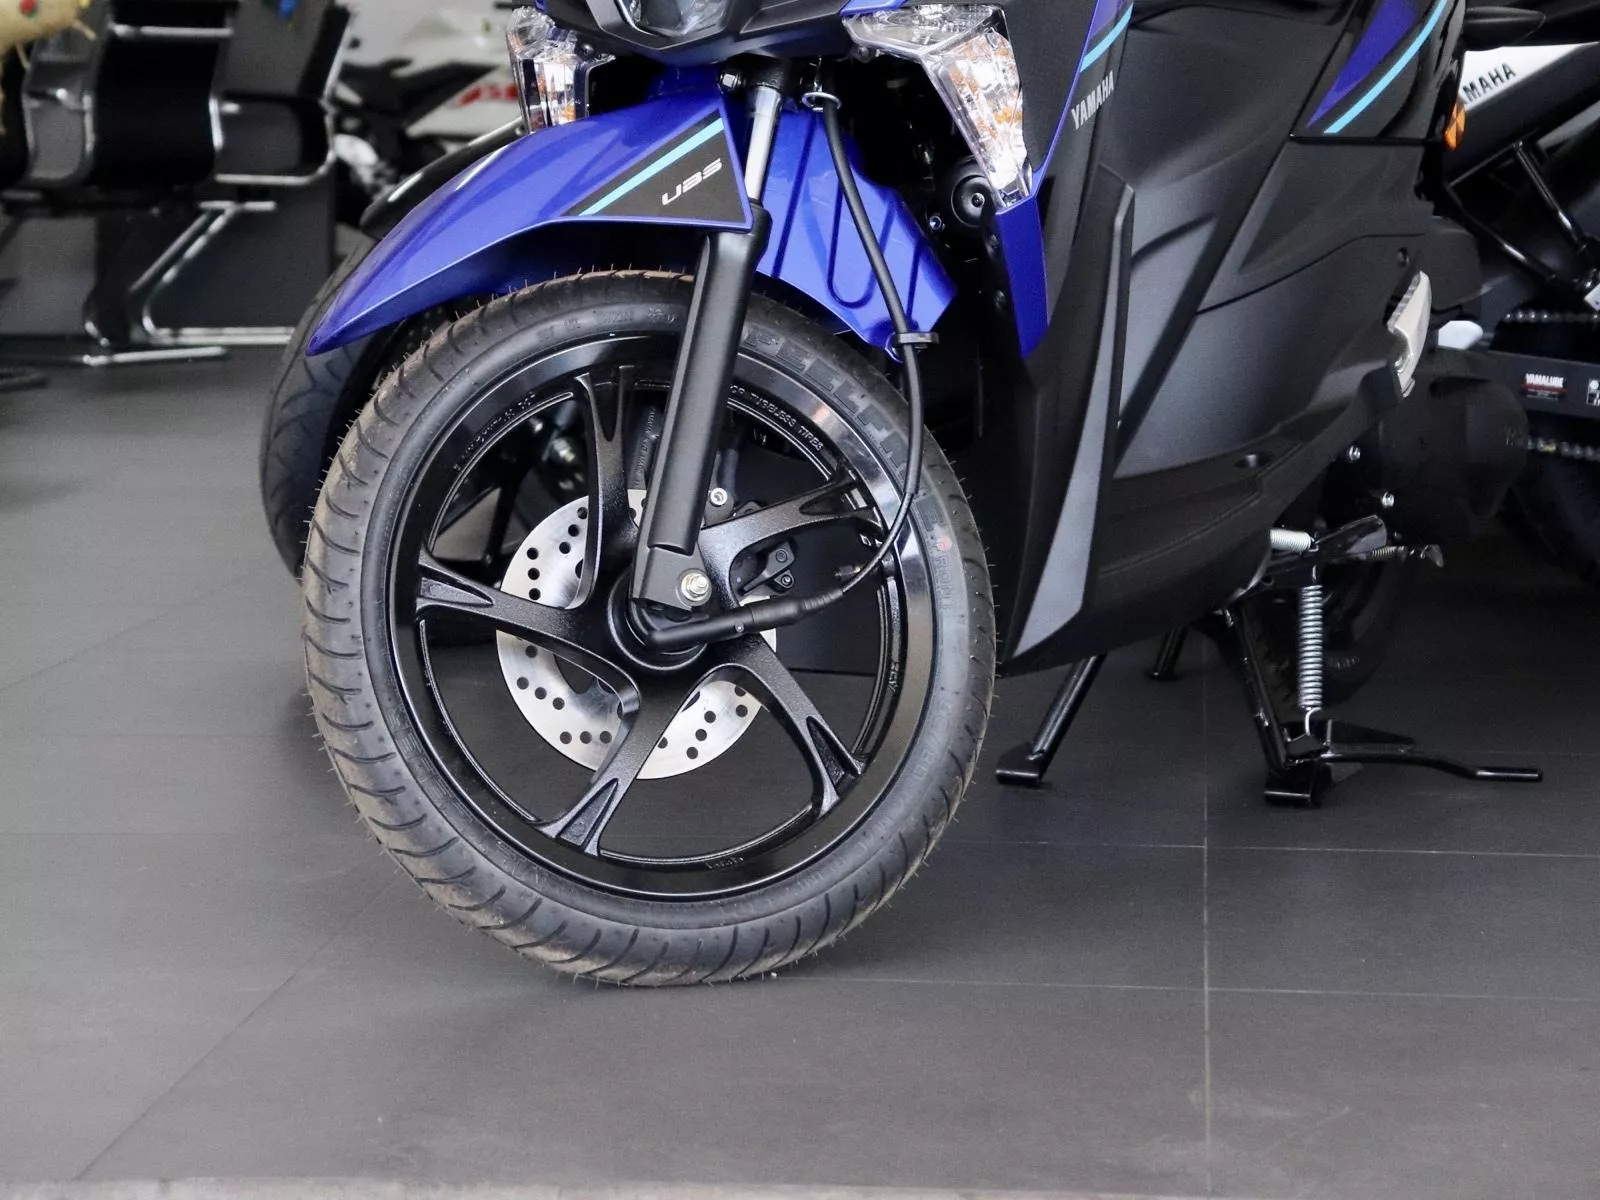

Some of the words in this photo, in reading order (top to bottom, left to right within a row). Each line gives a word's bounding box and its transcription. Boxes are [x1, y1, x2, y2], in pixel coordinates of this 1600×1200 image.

[1071, 70, 1114, 129] YAMAHA
[1461, 62, 1516, 104] MAHA
[662, 158, 722, 205] UBS
